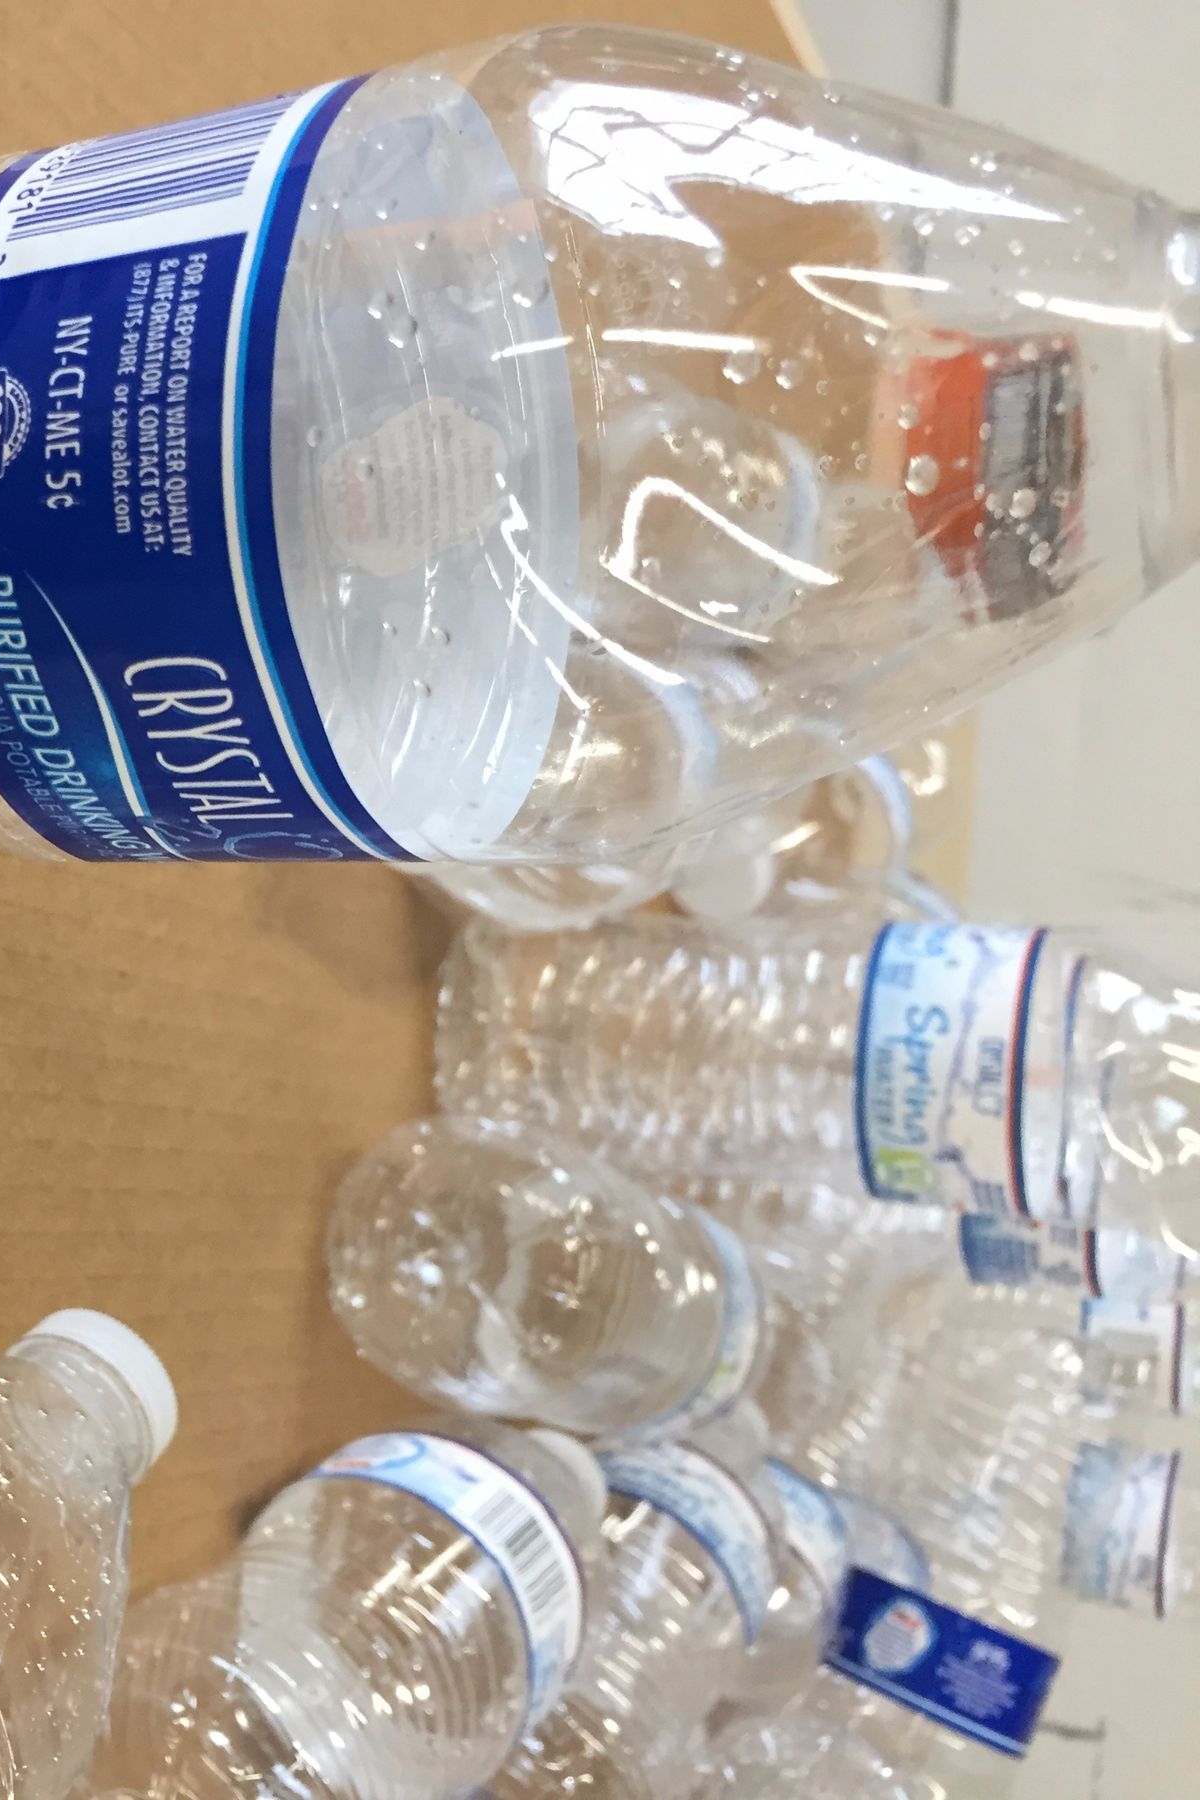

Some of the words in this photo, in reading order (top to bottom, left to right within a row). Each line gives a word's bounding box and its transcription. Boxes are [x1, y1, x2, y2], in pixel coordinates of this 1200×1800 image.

[159, 258, 180, 272] &
[179, 289, 200, 301] A
[181, 253, 208, 287] FOR
[169, 303, 198, 370] REPORT
[45, 315, 93, 460] NY-CT-ME
[114, 384, 129, 403] or
[167, 374, 188, 402] ON
[112, 407, 132, 533] savealot.com
[138, 404, 160, 488] CONTACT
[165, 406, 186, 472] WATER
[140, 493, 161, 518] US
[143, 523, 164, 552] AT:
[164, 477, 192, 557] QUALITY
[0, 739, 63, 814] POTABLE
[123, 656, 294, 832] CRYSTAL
[33, 748, 152, 852] DRINKING
[882, 1004, 949, 1146] Spring
